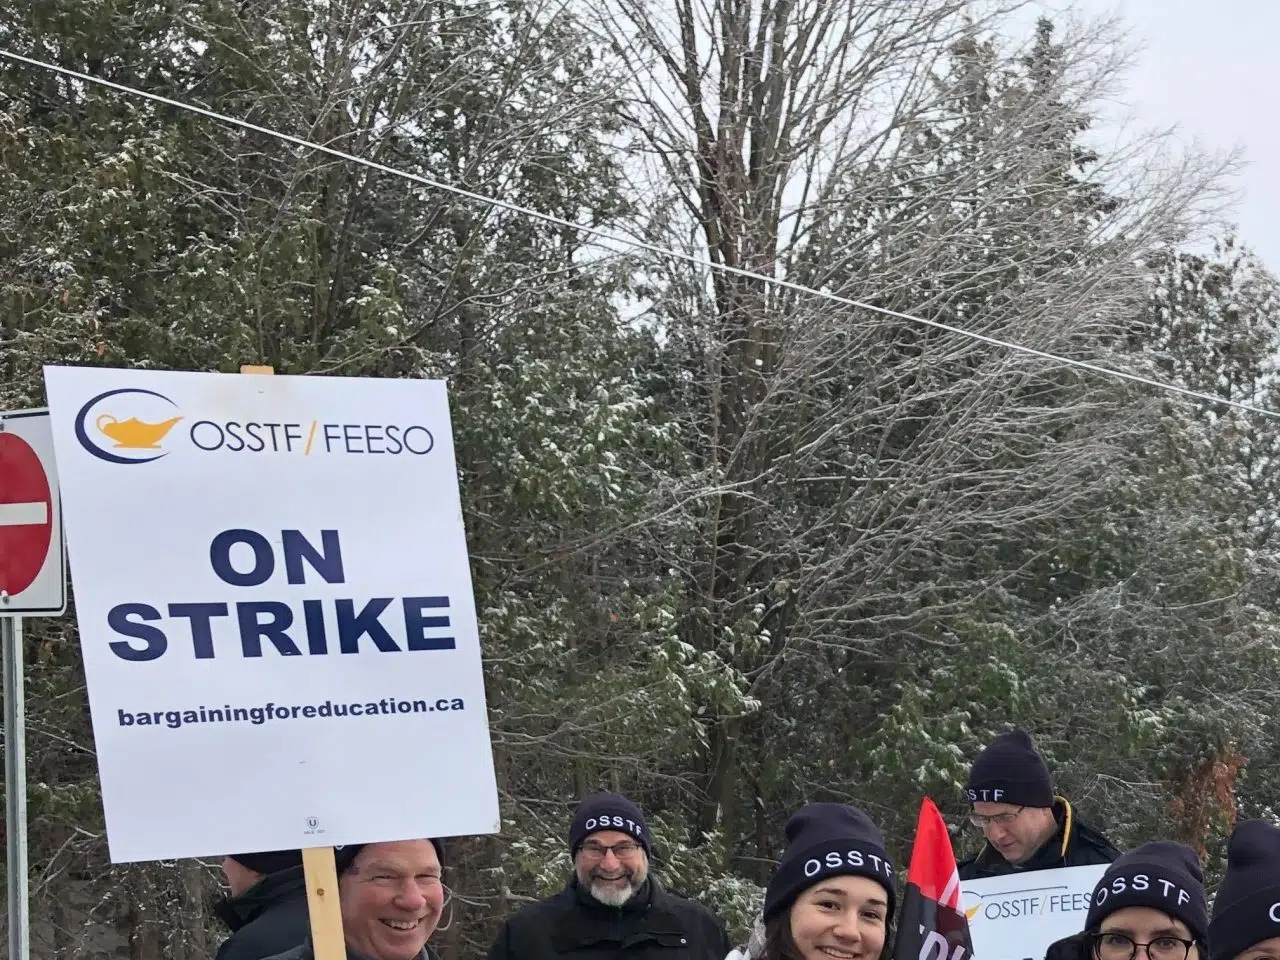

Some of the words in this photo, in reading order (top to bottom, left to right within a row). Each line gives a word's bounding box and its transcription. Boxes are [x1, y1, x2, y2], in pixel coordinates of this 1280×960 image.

[189, 419, 434, 456] OSSTF/FEESO
[209, 528, 346, 587] ON
[107, 595, 457, 662] STRIKE
[117, 697, 465, 729] bargainingforeducation.ca
[585, 815, 642, 836] OSSTF
[804, 850, 892, 878] OSSTF
[1096, 874, 1191, 907] OSSTF
